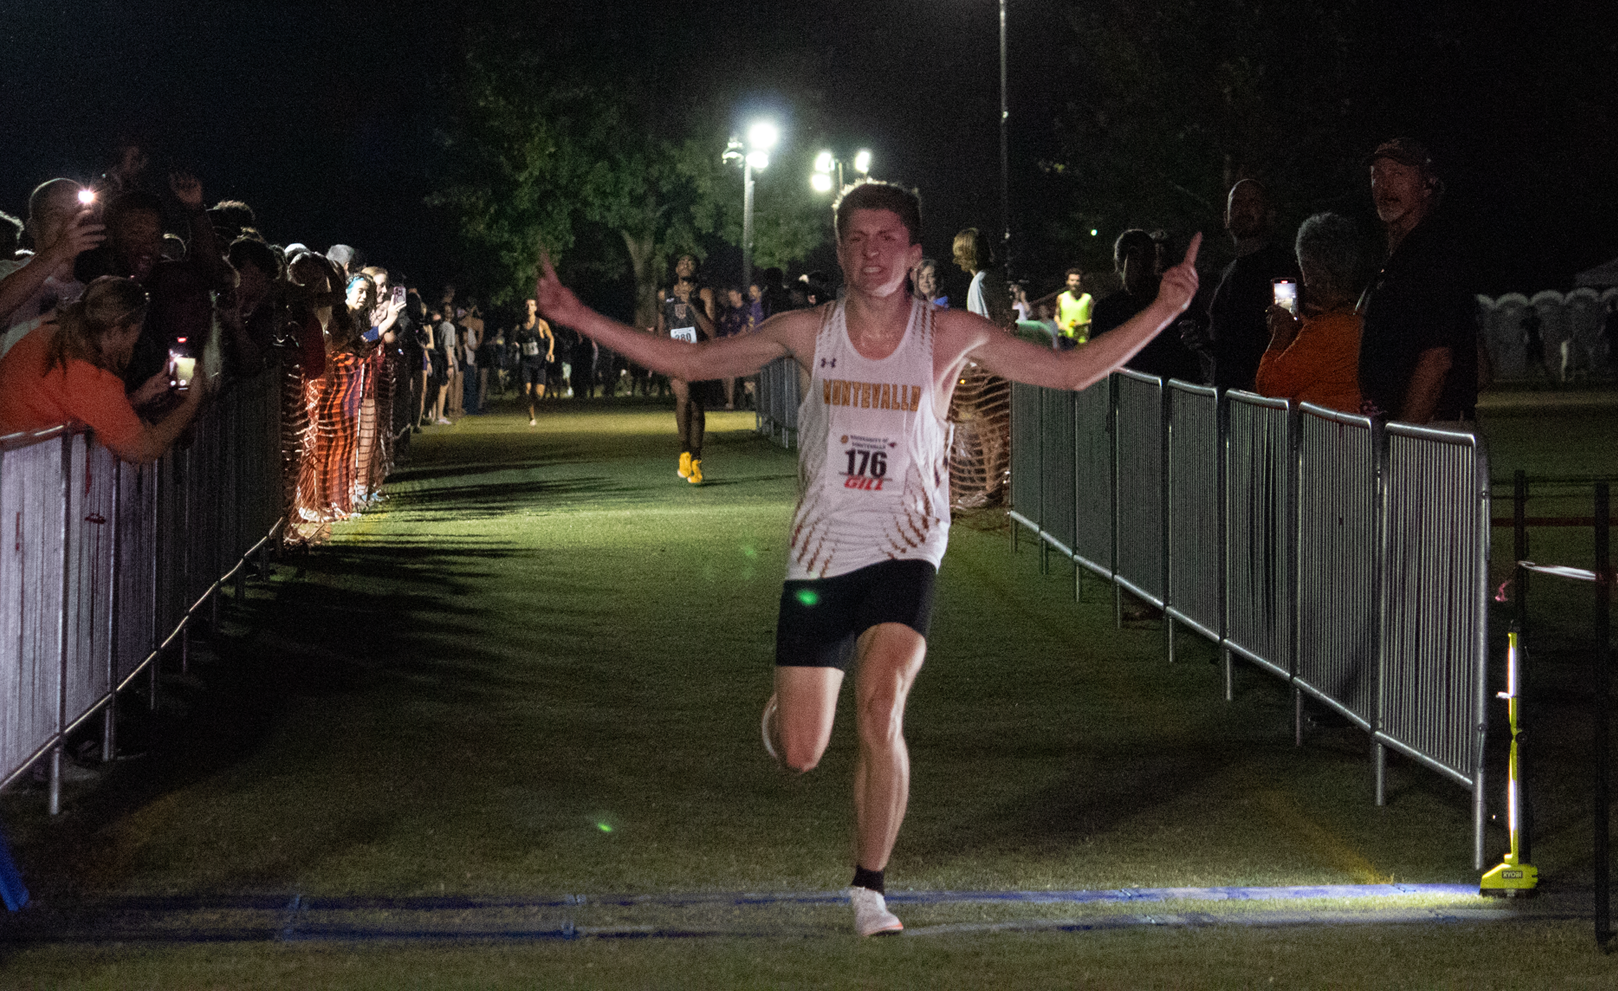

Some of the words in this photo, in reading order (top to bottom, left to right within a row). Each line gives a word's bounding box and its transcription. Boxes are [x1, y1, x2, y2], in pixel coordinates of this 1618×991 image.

[823, 379, 921, 412] MONTEVALLO
[845, 449, 887, 479] 176
[844, 475, 883, 491] GILL
